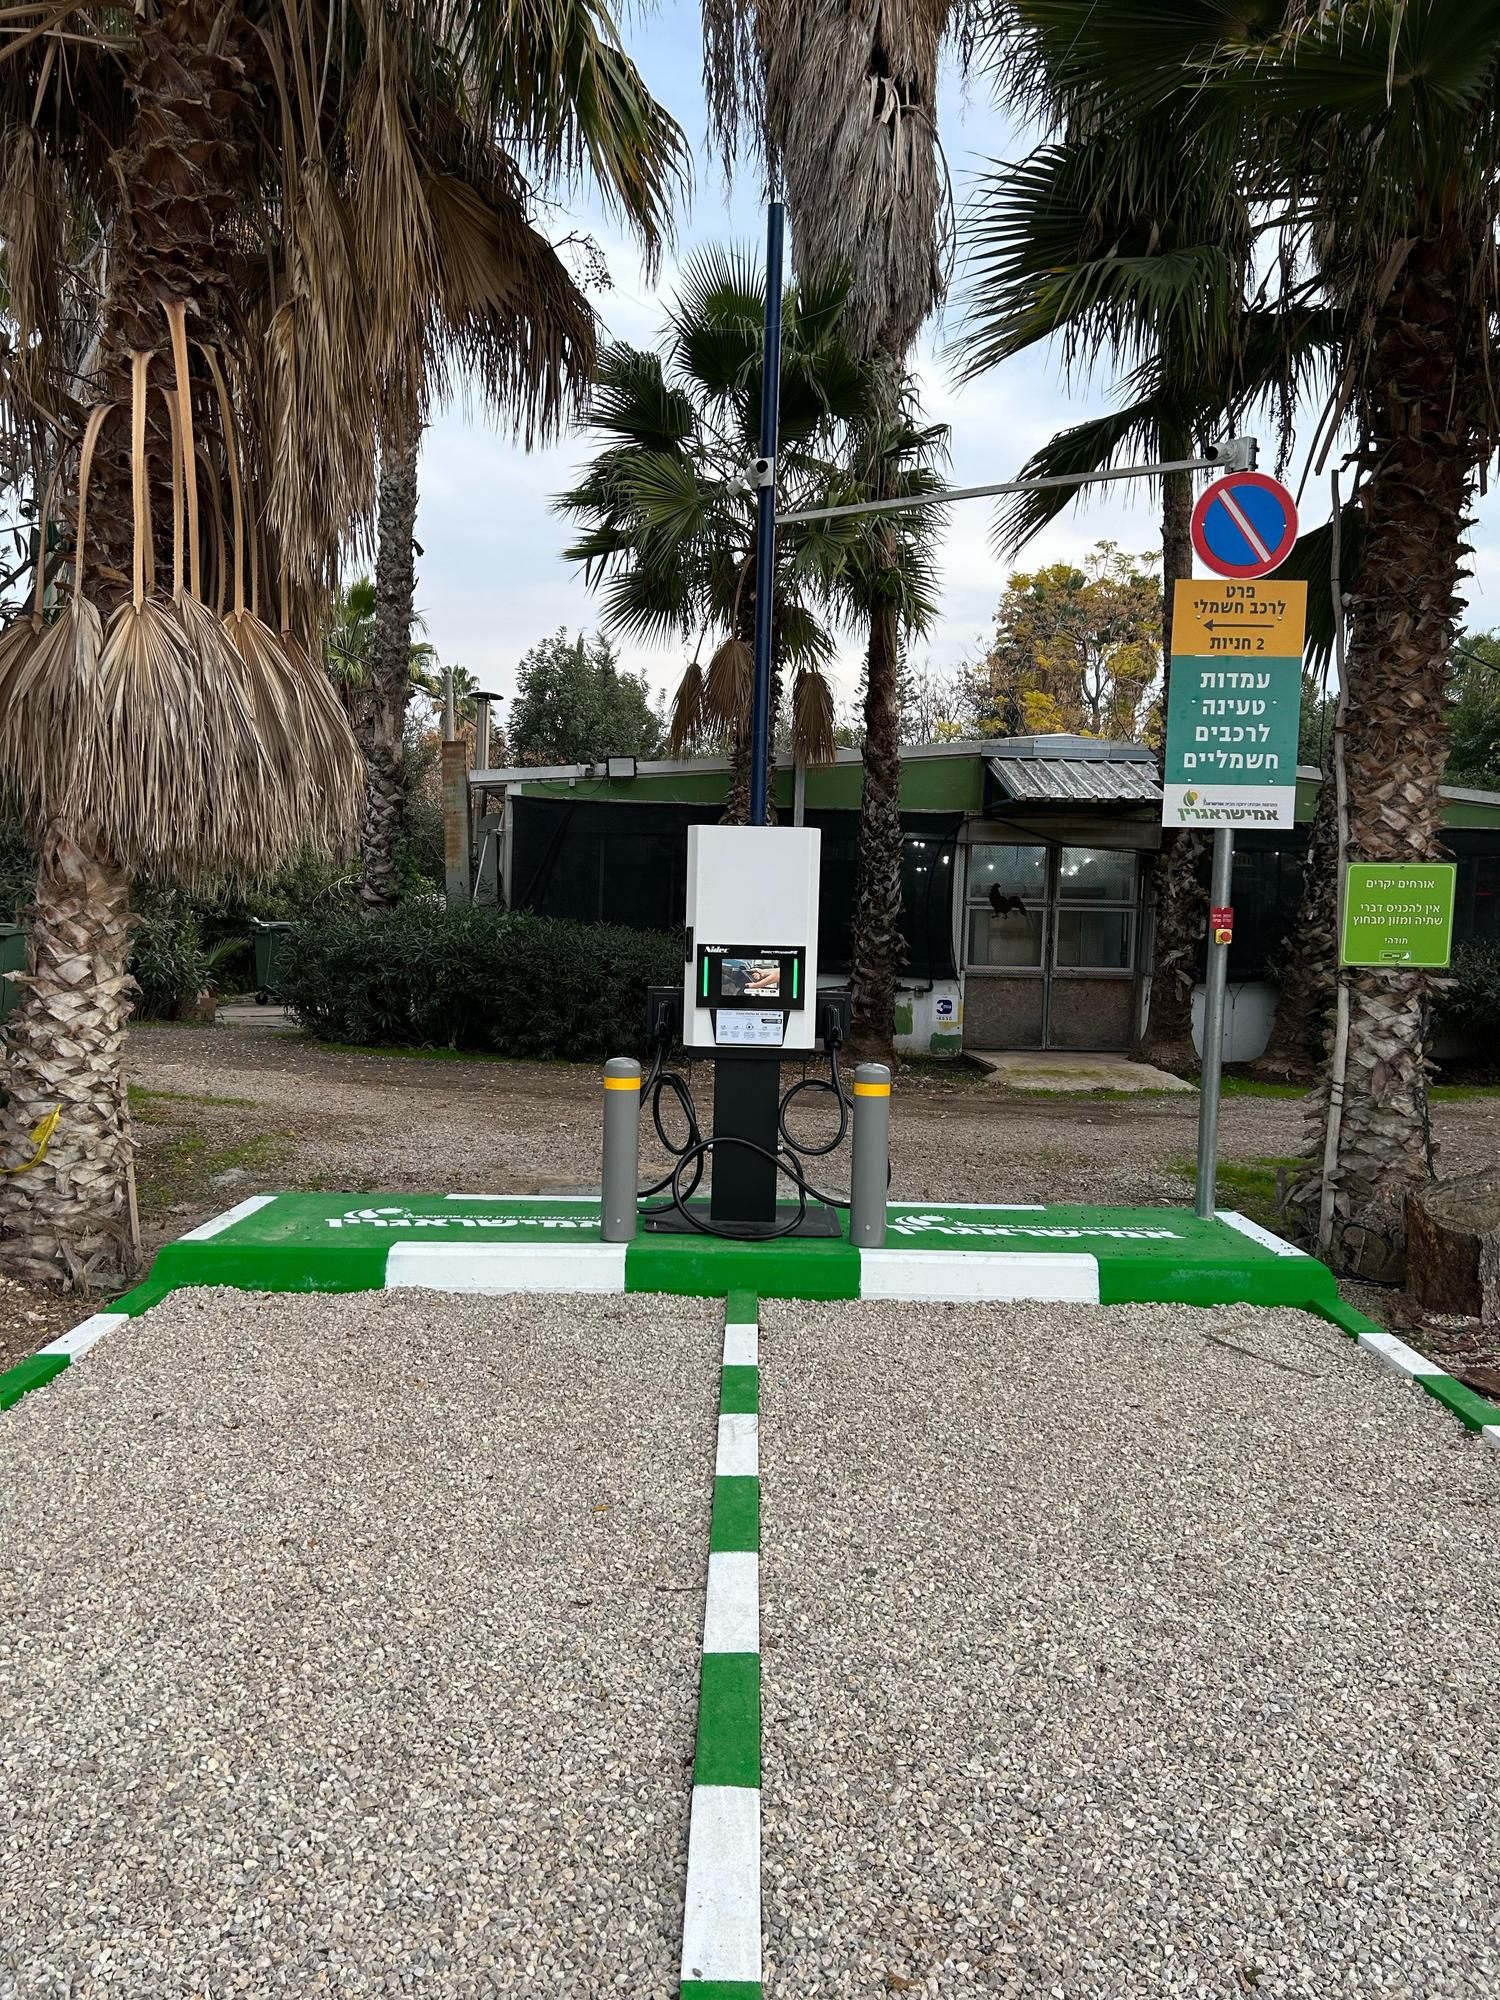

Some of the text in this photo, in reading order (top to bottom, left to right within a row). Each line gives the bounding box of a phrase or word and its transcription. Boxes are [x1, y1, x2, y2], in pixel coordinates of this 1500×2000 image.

[1226, 585, 1256, 599] פרט
[1194, 600, 1287, 615] לרכב חשמלי
[1210, 636, 1265, 650] 2 חניות
[1200, 672, 1271, 689] עמדות
[1202, 699, 1266, 716] טעינה
[1195, 724, 1271, 742] לרכבים
[1183, 751, 1279, 769] חשמליים
[1177, 808, 1280, 821] אמישראגרין
[1366, 880, 1435, 890] אורחים יקרים
[1361, 904, 1440, 914] אין להכניס דברי
[1353, 916, 1443, 926] שתיה ומזון מבחוץ
[1384, 937, 1408, 945] תודה!
[886, 1224, 1186, 1239] אמישראגרין
